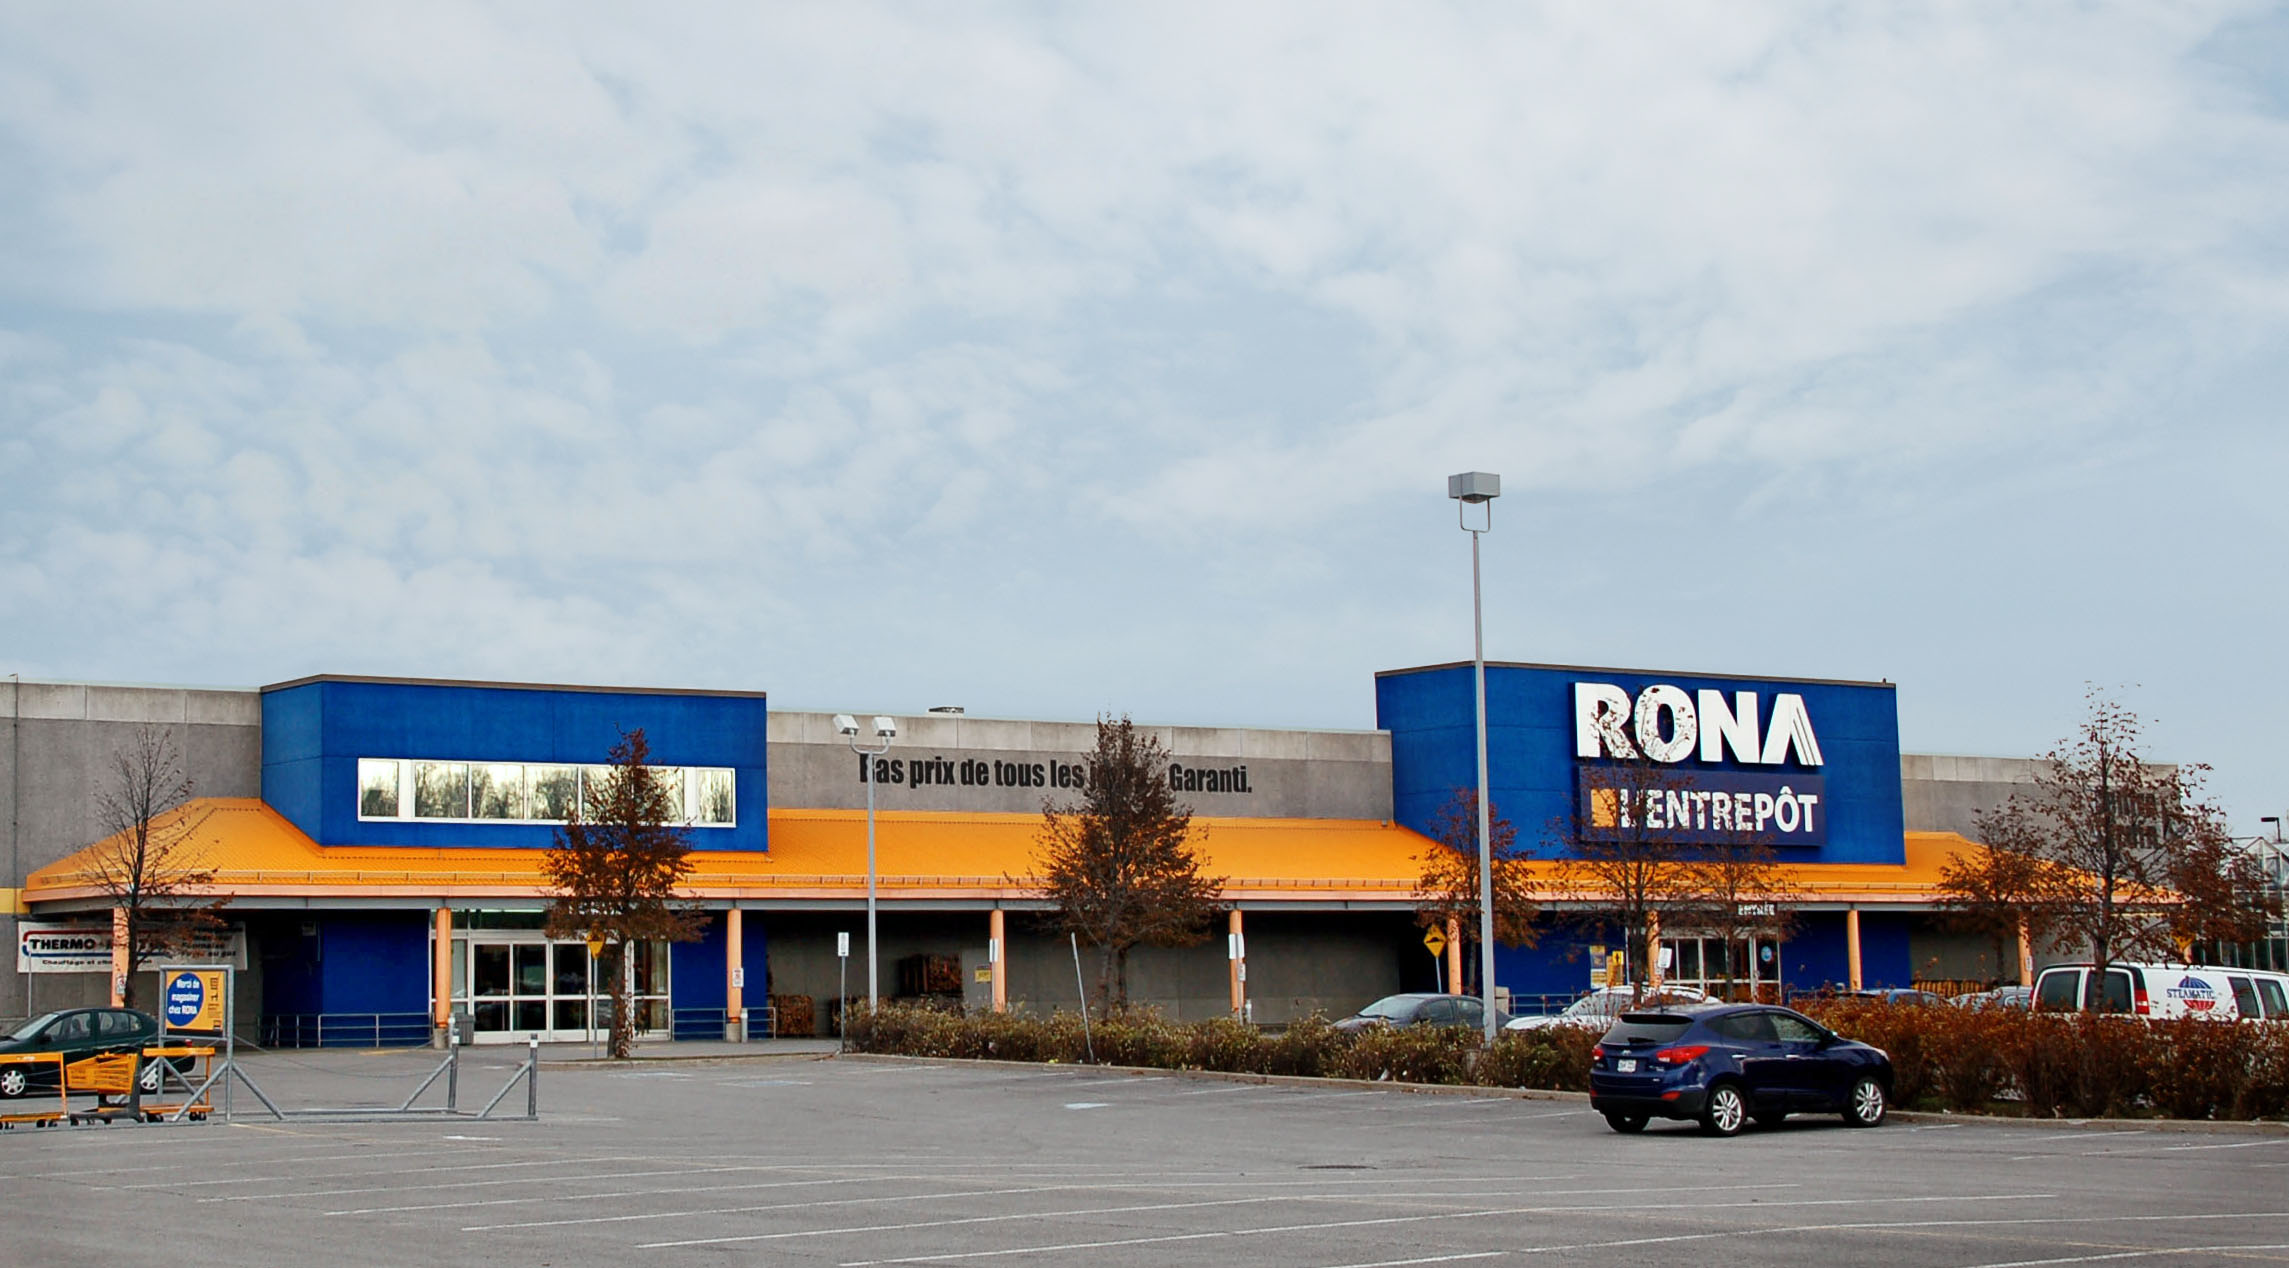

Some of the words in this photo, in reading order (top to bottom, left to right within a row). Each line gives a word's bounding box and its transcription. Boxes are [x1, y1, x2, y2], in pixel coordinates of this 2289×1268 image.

[1575, 682, 1824, 766] RONA
[910, 756, 955, 789] prix
[960, 759, 989, 786] de
[994, 760, 1045, 787] tous
[1050, 759, 1085, 788] les
[1169, 763, 1252, 793] Garanti.
[29, 938, 96, 950] THERMO
